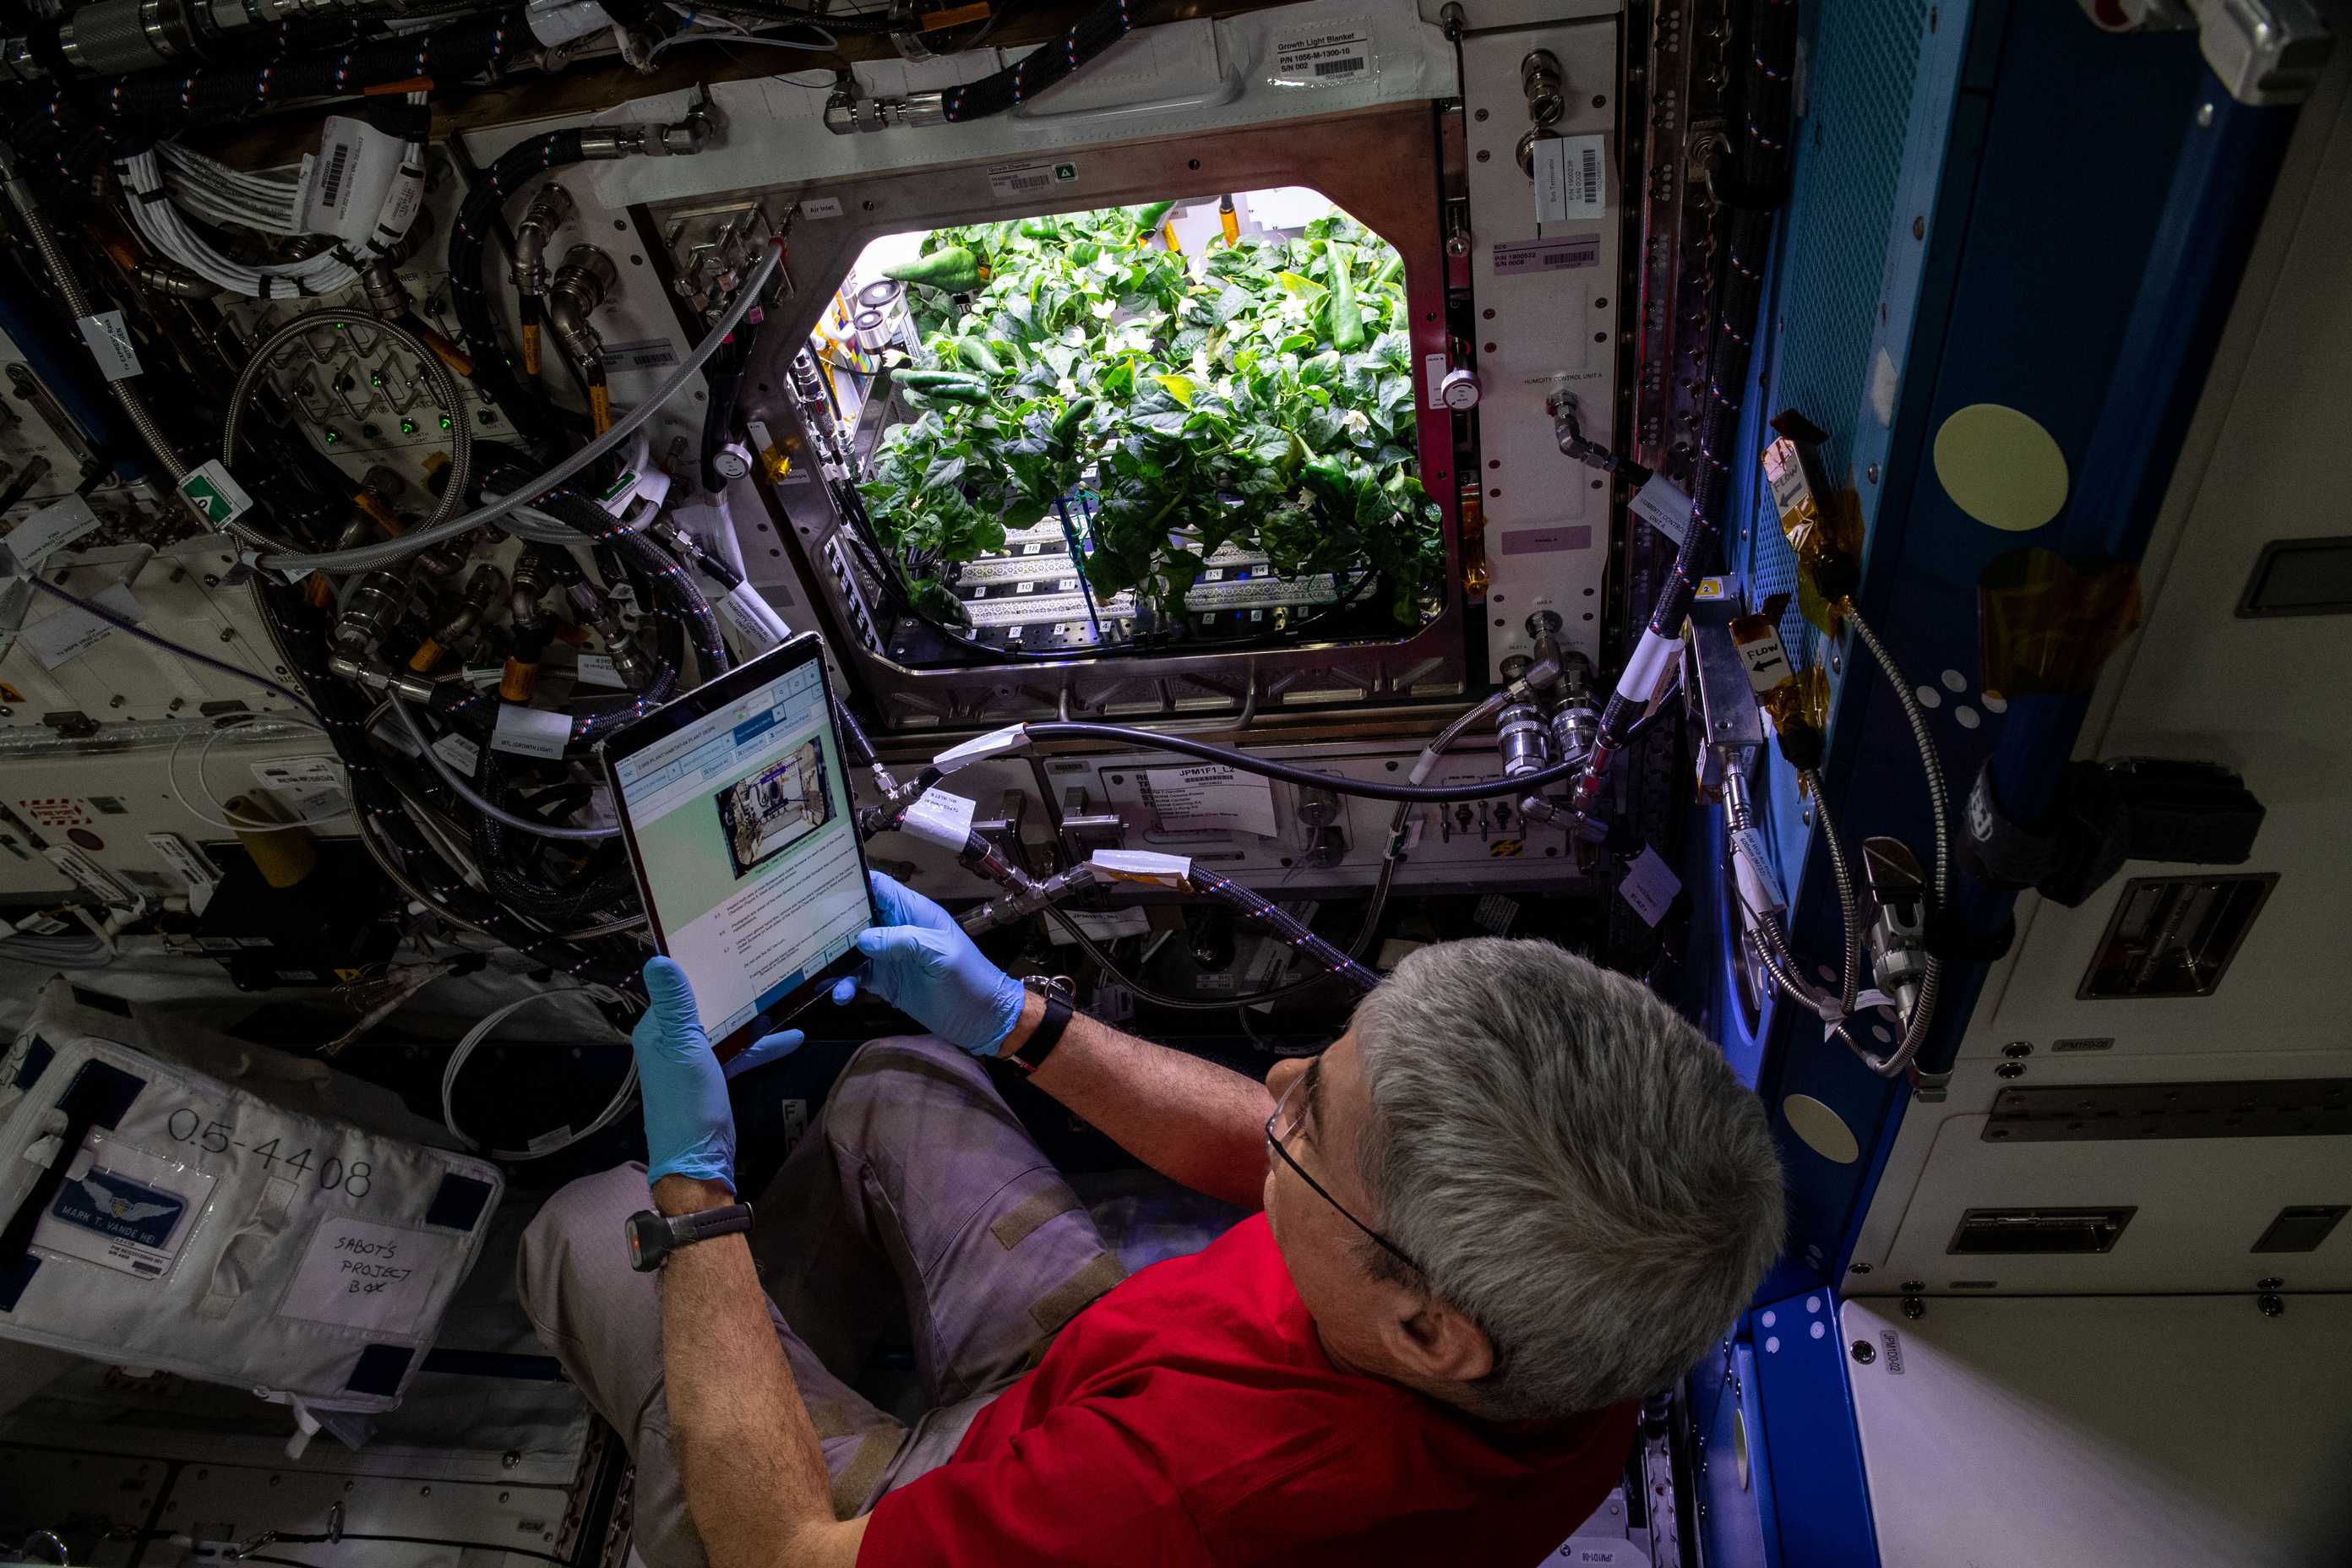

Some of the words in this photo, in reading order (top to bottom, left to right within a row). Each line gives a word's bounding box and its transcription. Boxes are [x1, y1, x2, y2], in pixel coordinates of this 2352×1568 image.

[1278, 40, 1304, 51] Growth
[1306, 37, 1325, 48] Light
[1326, 33, 1354, 44] Blanket
[1280, 55, 1293, 64] P/N
[1294, 47, 1350, 62] 1056-M-1300-10
[1281, 64, 1294, 73] S/N
[423, 270, 431, 279] 3
[959, 304, 972, 313] 10
[1554, 373, 1582, 382] CONTROL
[1773, 465, 1797, 492] FLOW
[1746, 643, 1778, 659] FLOW
[1179, 765, 1234, 776] JPM1F1_L2
[168, 1108, 370, 1197] 0.5-4408
[59, 1204, 90, 1222] MARK
[95, 1216, 103, 1226] T.
[106, 1221, 137, 1237] VANDE
[139, 1231, 156, 1244] HEI
[335, 1237, 398, 1259] SABOT'S
[340, 1260, 411, 1282] PROJECT
[349, 1280, 386, 1294] BOX
[1883, 1334, 1900, 1370] JPM1D0-02
